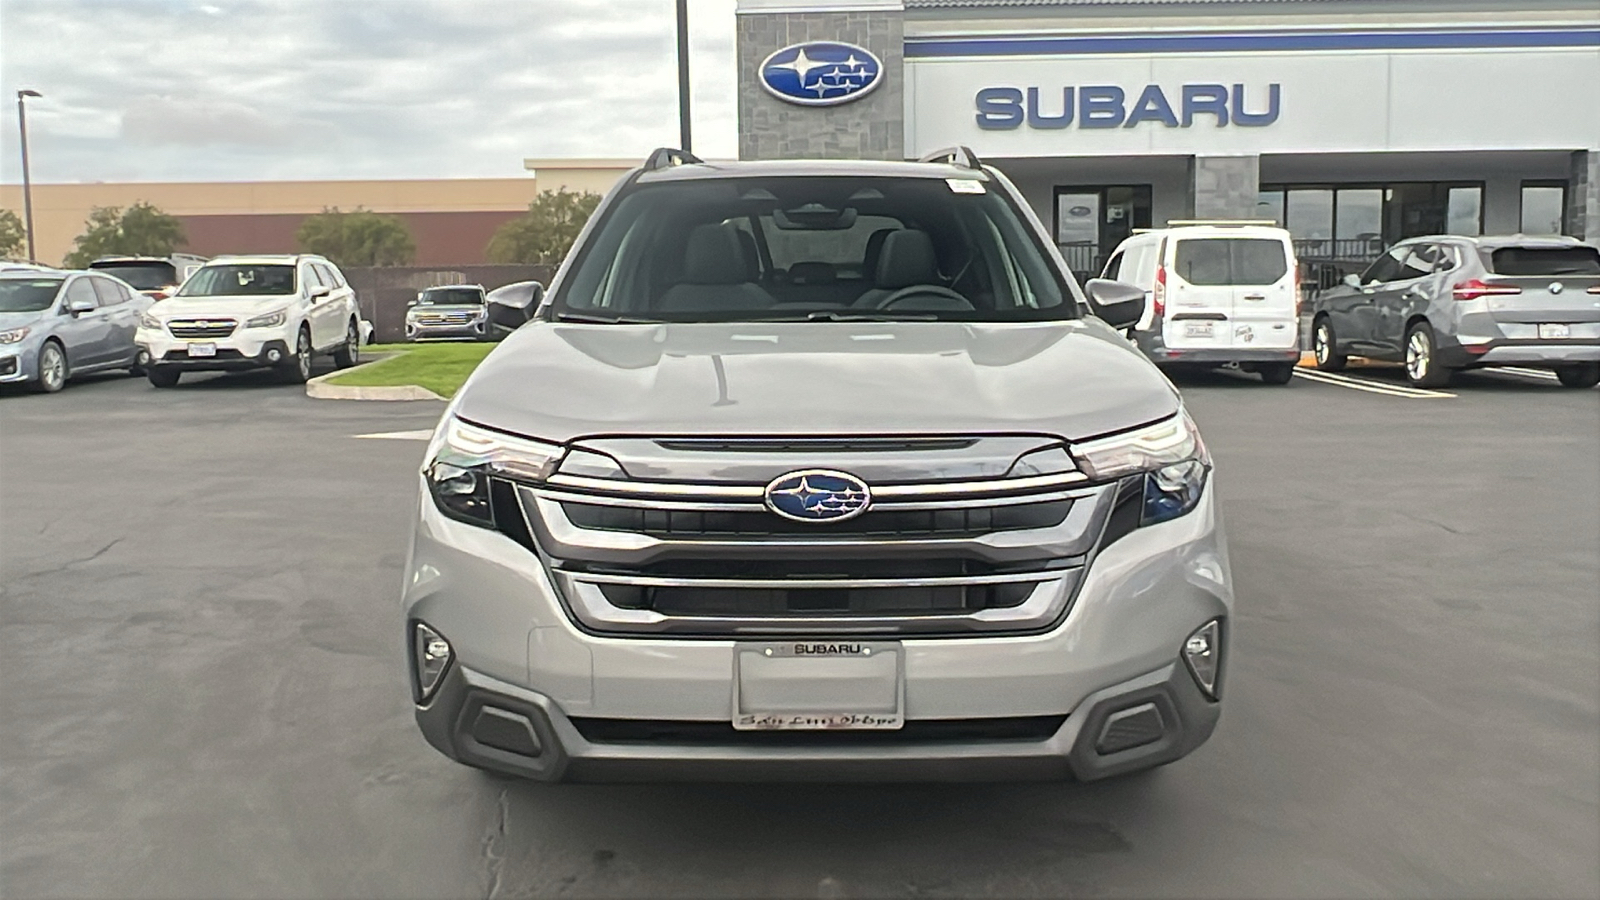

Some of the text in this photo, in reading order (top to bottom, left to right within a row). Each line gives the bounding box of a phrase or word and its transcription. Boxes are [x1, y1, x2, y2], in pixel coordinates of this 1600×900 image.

[976, 83, 1280, 130] SUBARU
[795, 643, 860, 654] SUBARU
[740, 715, 783, 725] San
